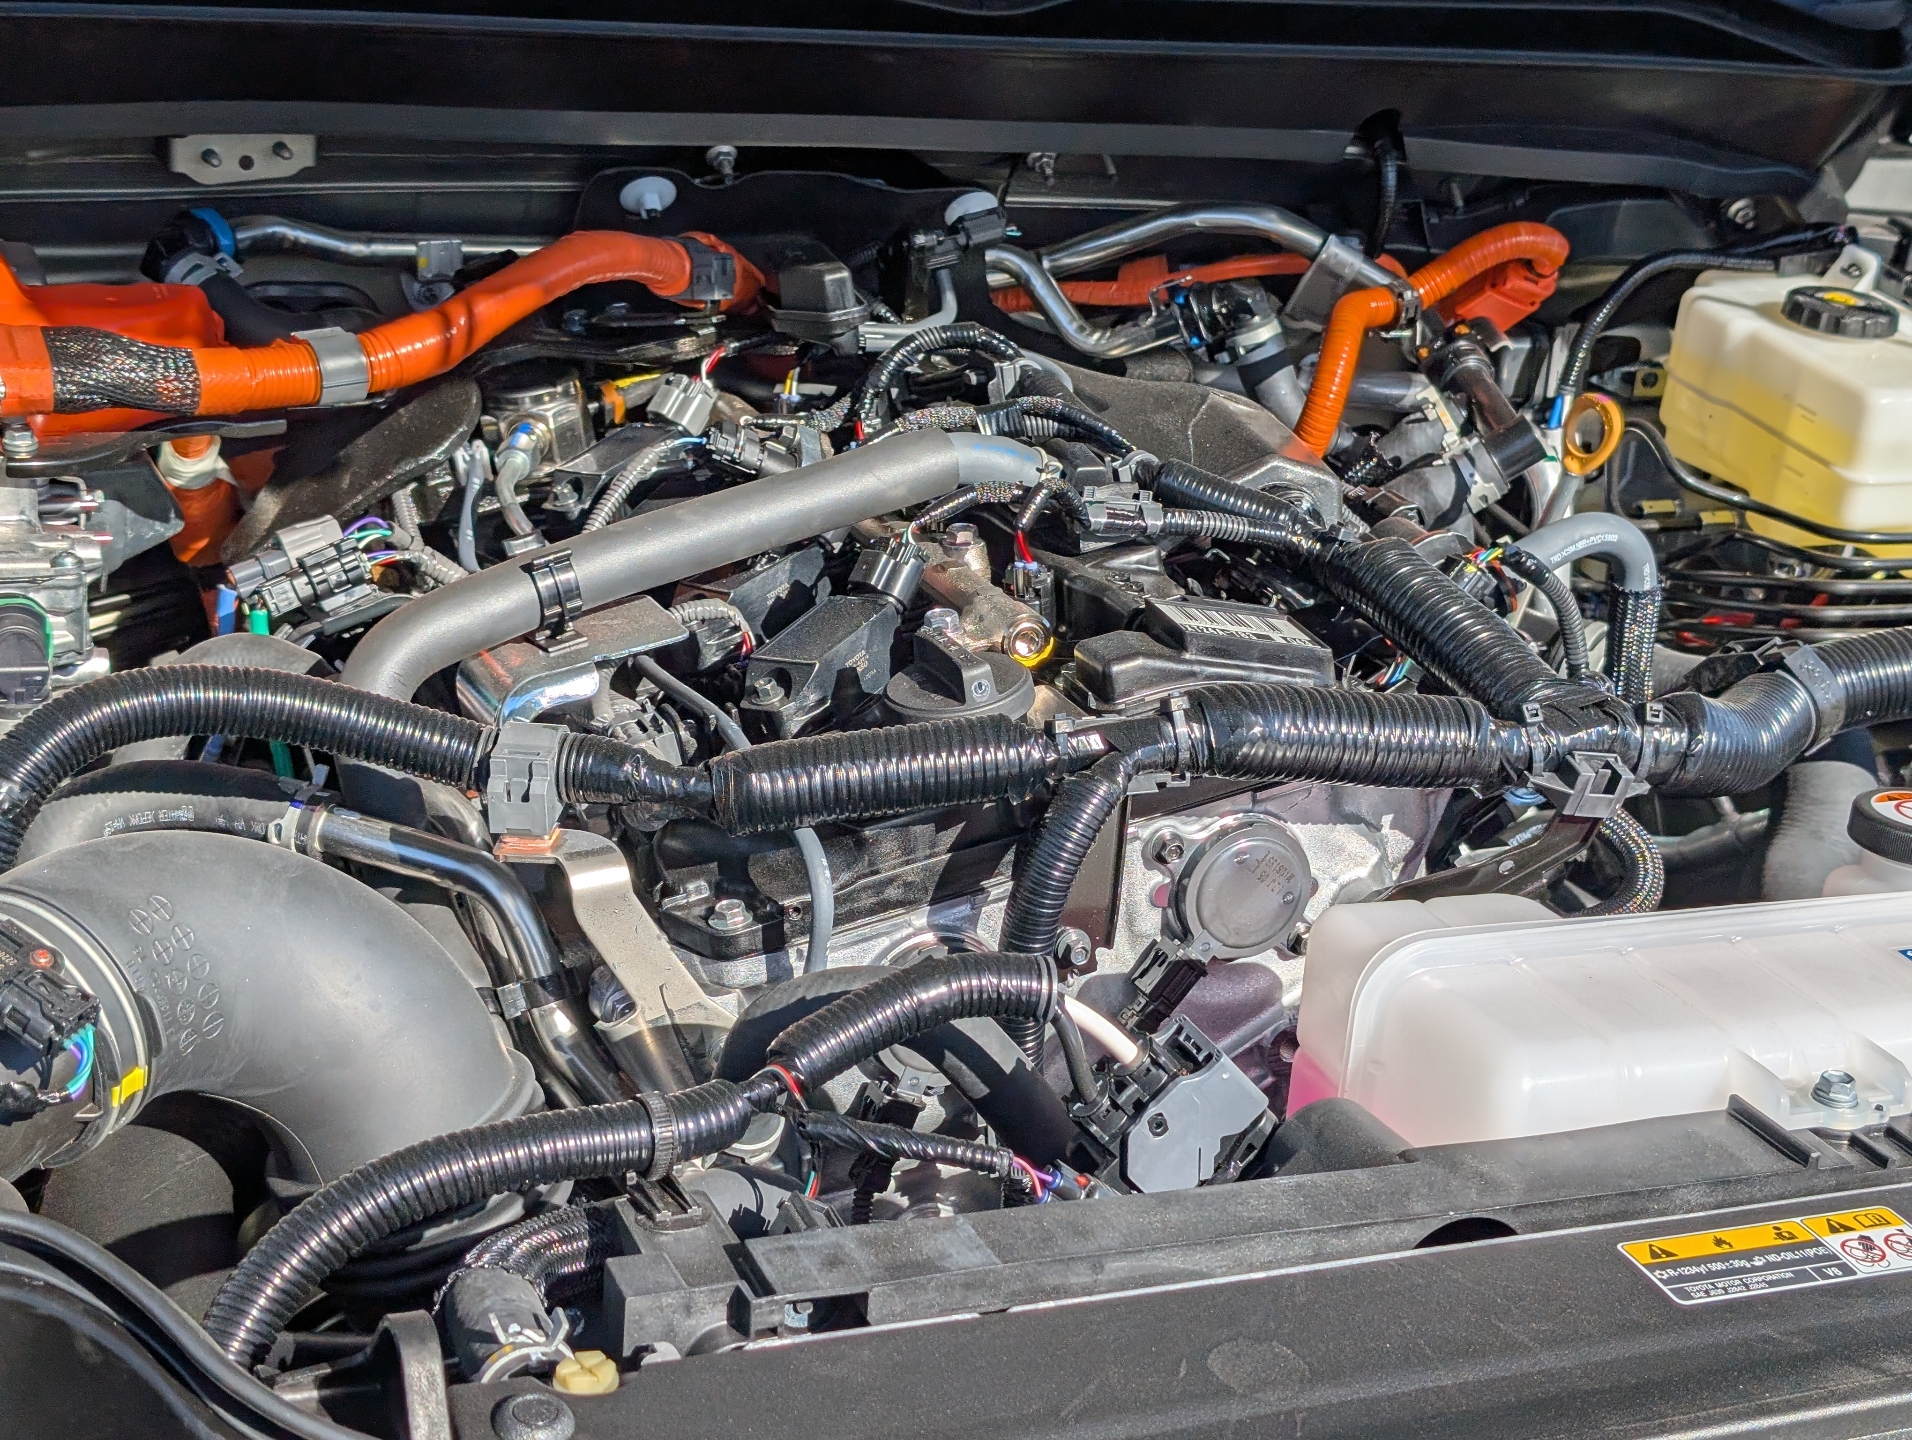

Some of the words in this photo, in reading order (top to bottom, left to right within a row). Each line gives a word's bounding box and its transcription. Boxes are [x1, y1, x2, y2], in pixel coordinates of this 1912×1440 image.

[766, 582, 791, 599] TOYOTA
[845, 650, 866, 668] TOYOTA
[1684, 1283, 1715, 1293] TOYOTA
[1715, 1279, 1743, 1288] MOTOR
[1743, 1272, 1795, 1284] CORPORATION
